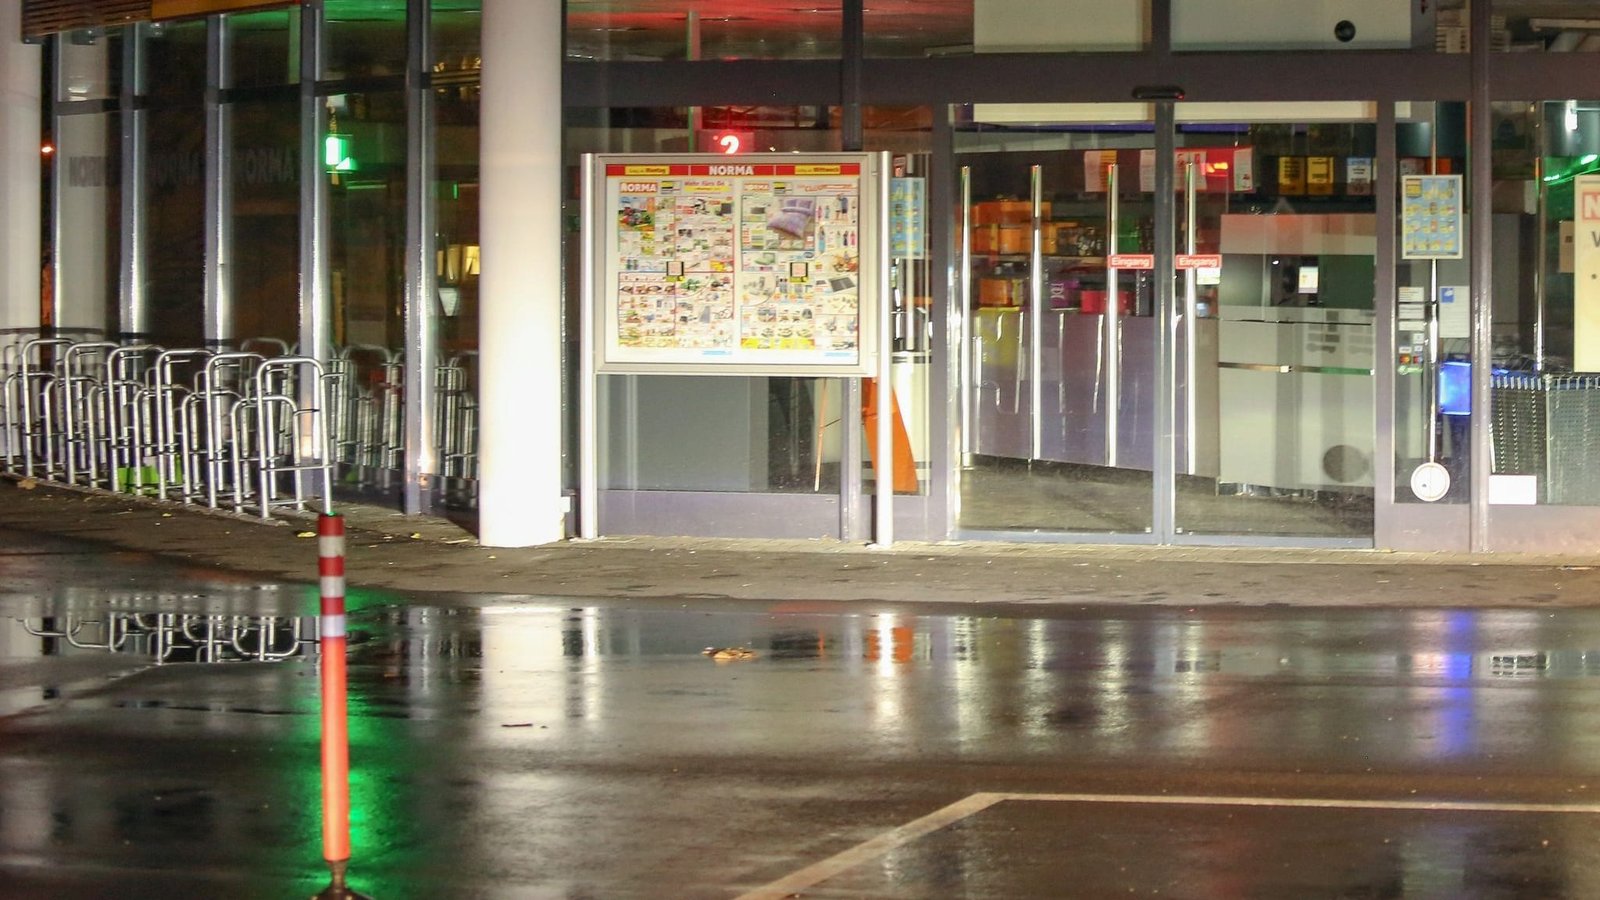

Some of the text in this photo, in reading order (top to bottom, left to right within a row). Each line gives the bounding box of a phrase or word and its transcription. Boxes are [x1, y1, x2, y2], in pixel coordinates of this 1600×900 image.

[708, 164, 754, 176] NORMA
[620, 182, 657, 192] NORMA
[1111, 256, 1150, 267] Eingang
[1179, 256, 1218, 267] Eingang
